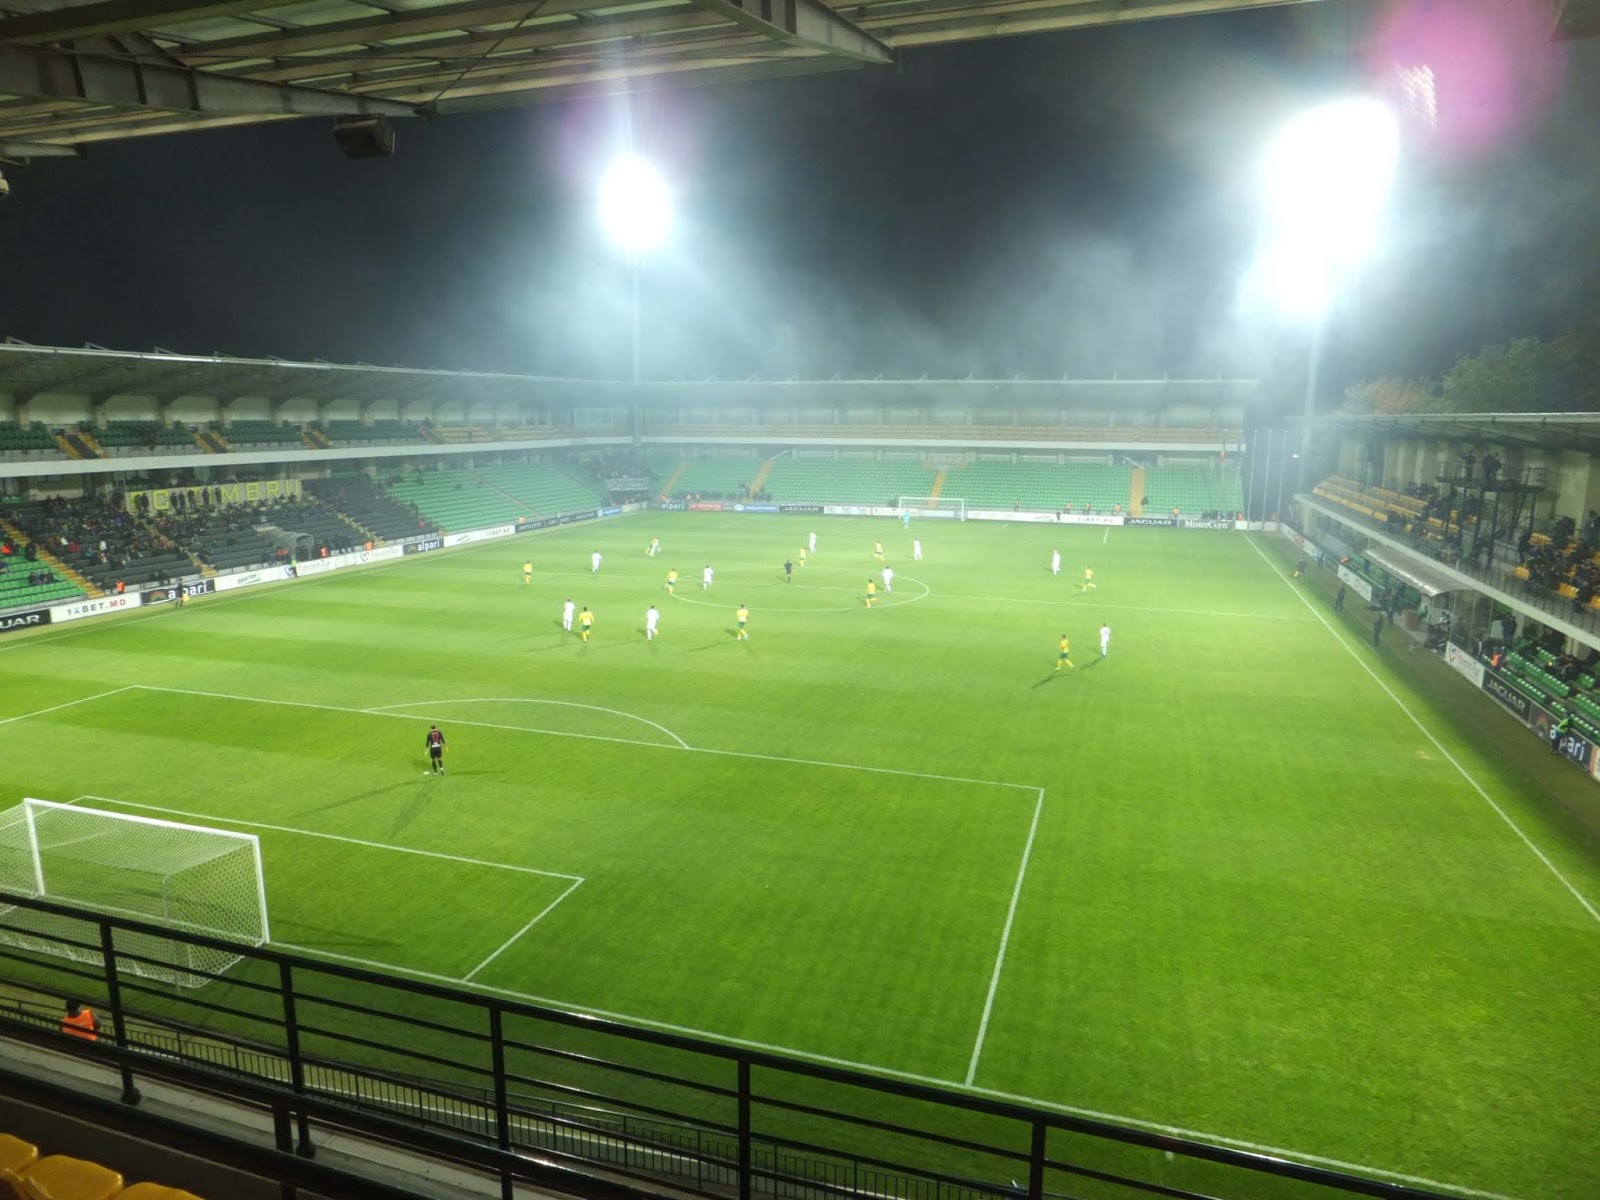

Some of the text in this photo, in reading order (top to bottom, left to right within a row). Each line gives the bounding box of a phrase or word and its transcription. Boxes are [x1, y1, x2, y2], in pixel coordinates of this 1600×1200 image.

[661, 499, 684, 510] alpari
[1128, 518, 1171, 526] JAGUAR
[417, 539, 440, 552] alpari
[168, 580, 207, 599] apari
[67, 598, 126, 616] 1XBET.MD
[1488, 678, 1525, 712] JAGUAR
[1549, 724, 1585, 761] apari
